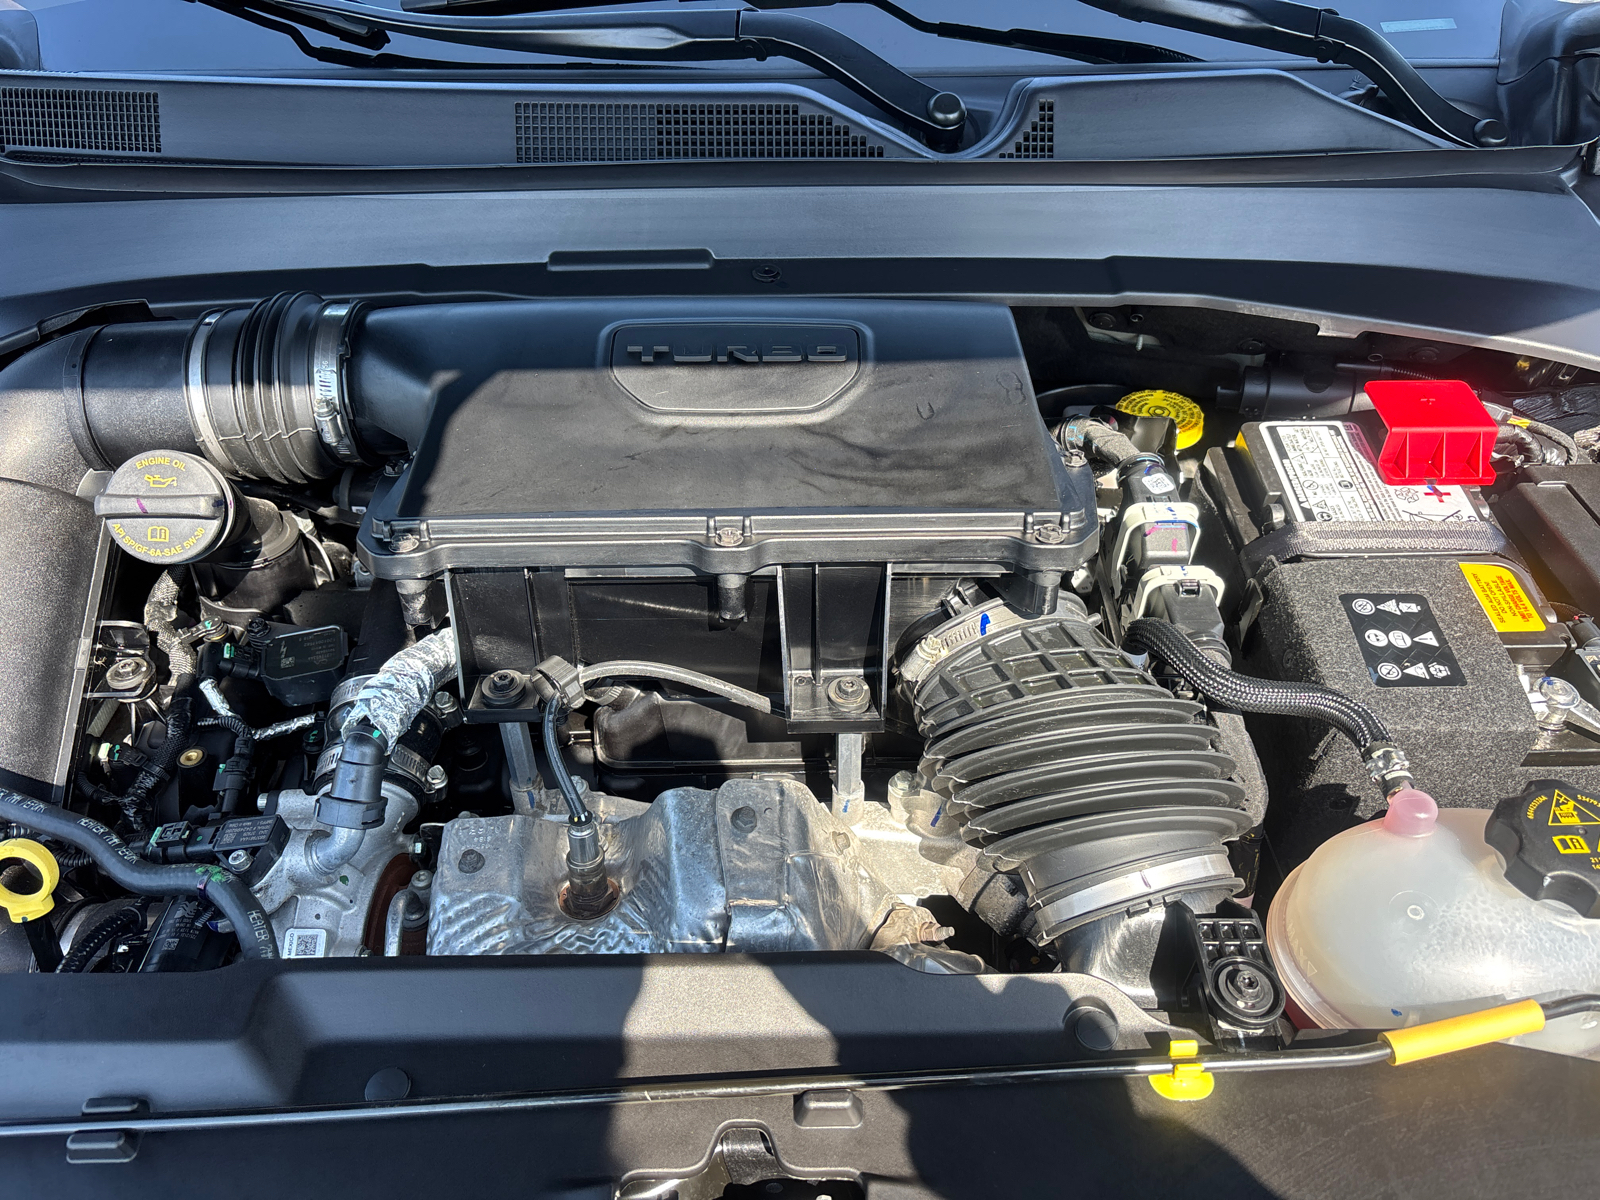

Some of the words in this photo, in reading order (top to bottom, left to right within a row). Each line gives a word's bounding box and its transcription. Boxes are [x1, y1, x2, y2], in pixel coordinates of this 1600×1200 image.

[627, 344, 848, 363] TURBO
[135, 456, 171, 470] ENGINE
[172, 459, 187, 472] OIL
[112, 522, 126, 539] API
[184, 527, 206, 549] 5W-30
[1471, 572, 1488, 593] BATTERY
[1490, 579, 1519, 617] NON-SPILLABLE
[1492, 596, 1503, 606] NOT
[1506, 593, 1521, 611] CHARGE
[1490, 604, 1506, 623] SEALED
[1498, 606, 1508, 614] DO
[1517, 610, 1530, 623] LIMIT
[77, 817, 109, 835] HEATER
[247, 909, 270, 943] HEATER
